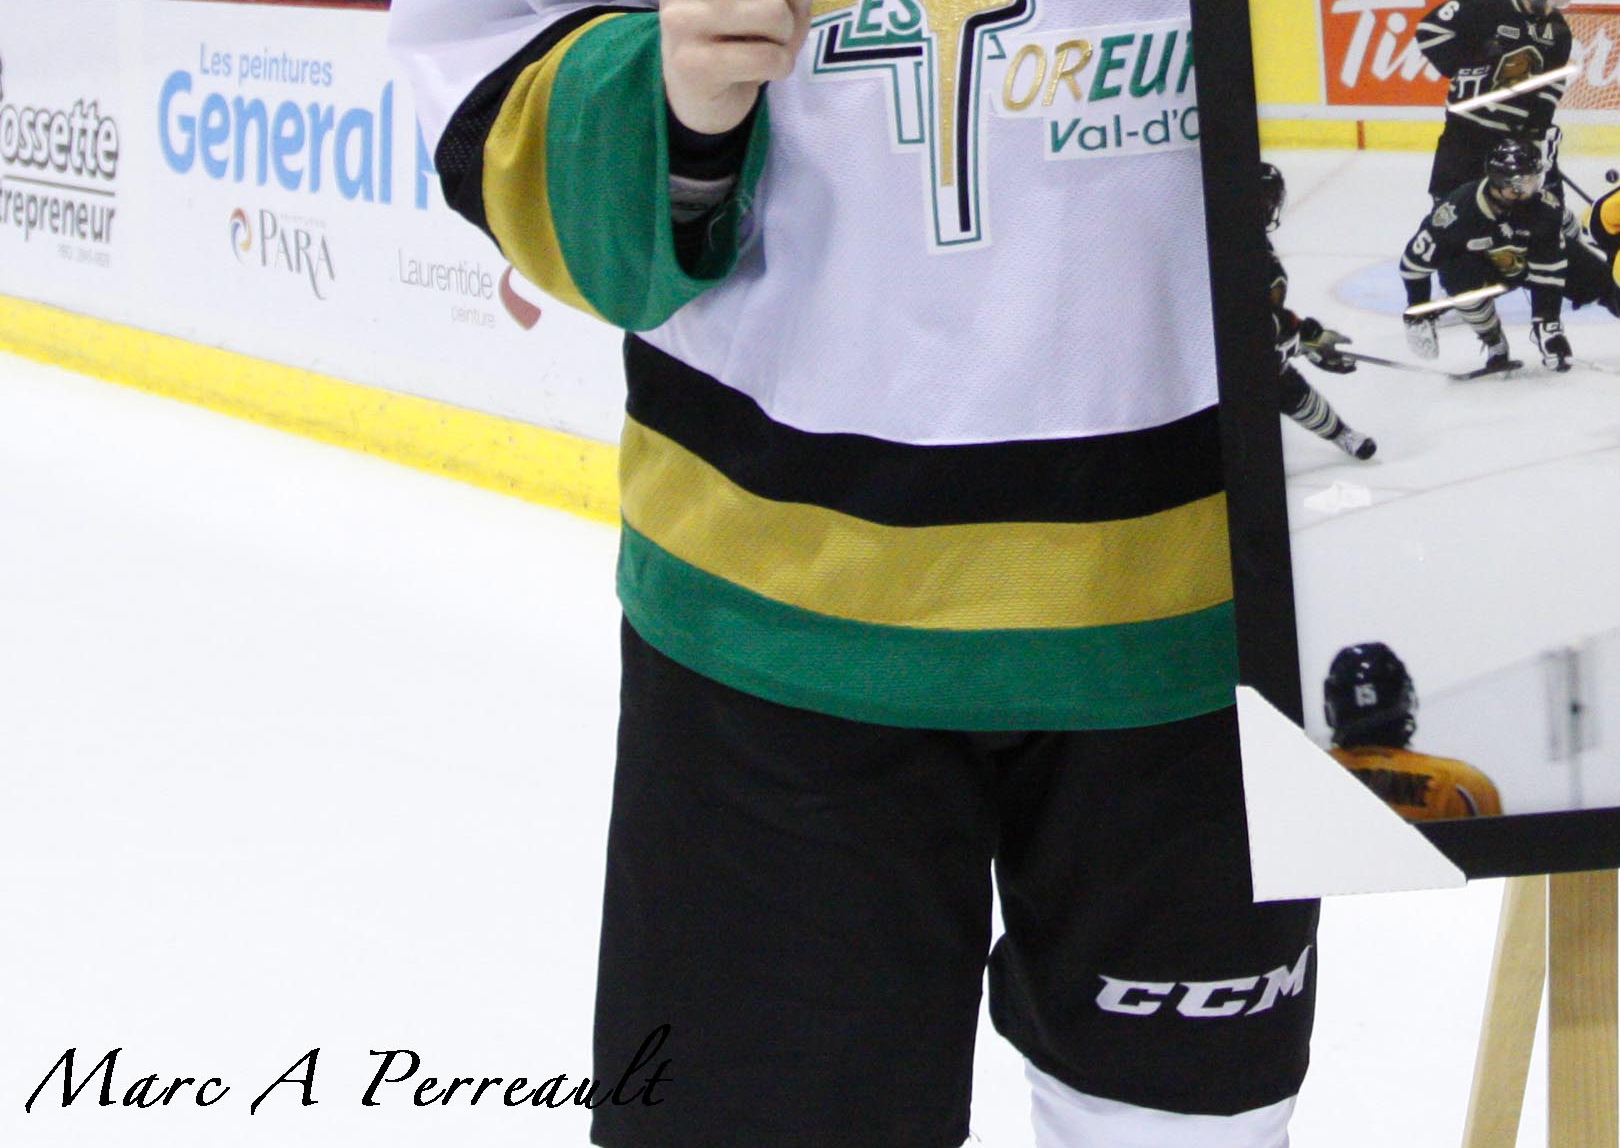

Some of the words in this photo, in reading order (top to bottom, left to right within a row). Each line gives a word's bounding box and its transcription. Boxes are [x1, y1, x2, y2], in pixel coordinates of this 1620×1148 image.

[199, 43, 232, 77] Les
[238, 47, 333, 88] peintures
[158, 69, 394, 205] General
[0, 186, 116, 244] repreneur
[259, 208, 336, 301] PARA
[398, 248, 494, 301] Laurentide
[1095, 944, 1313, 1018] CCM
